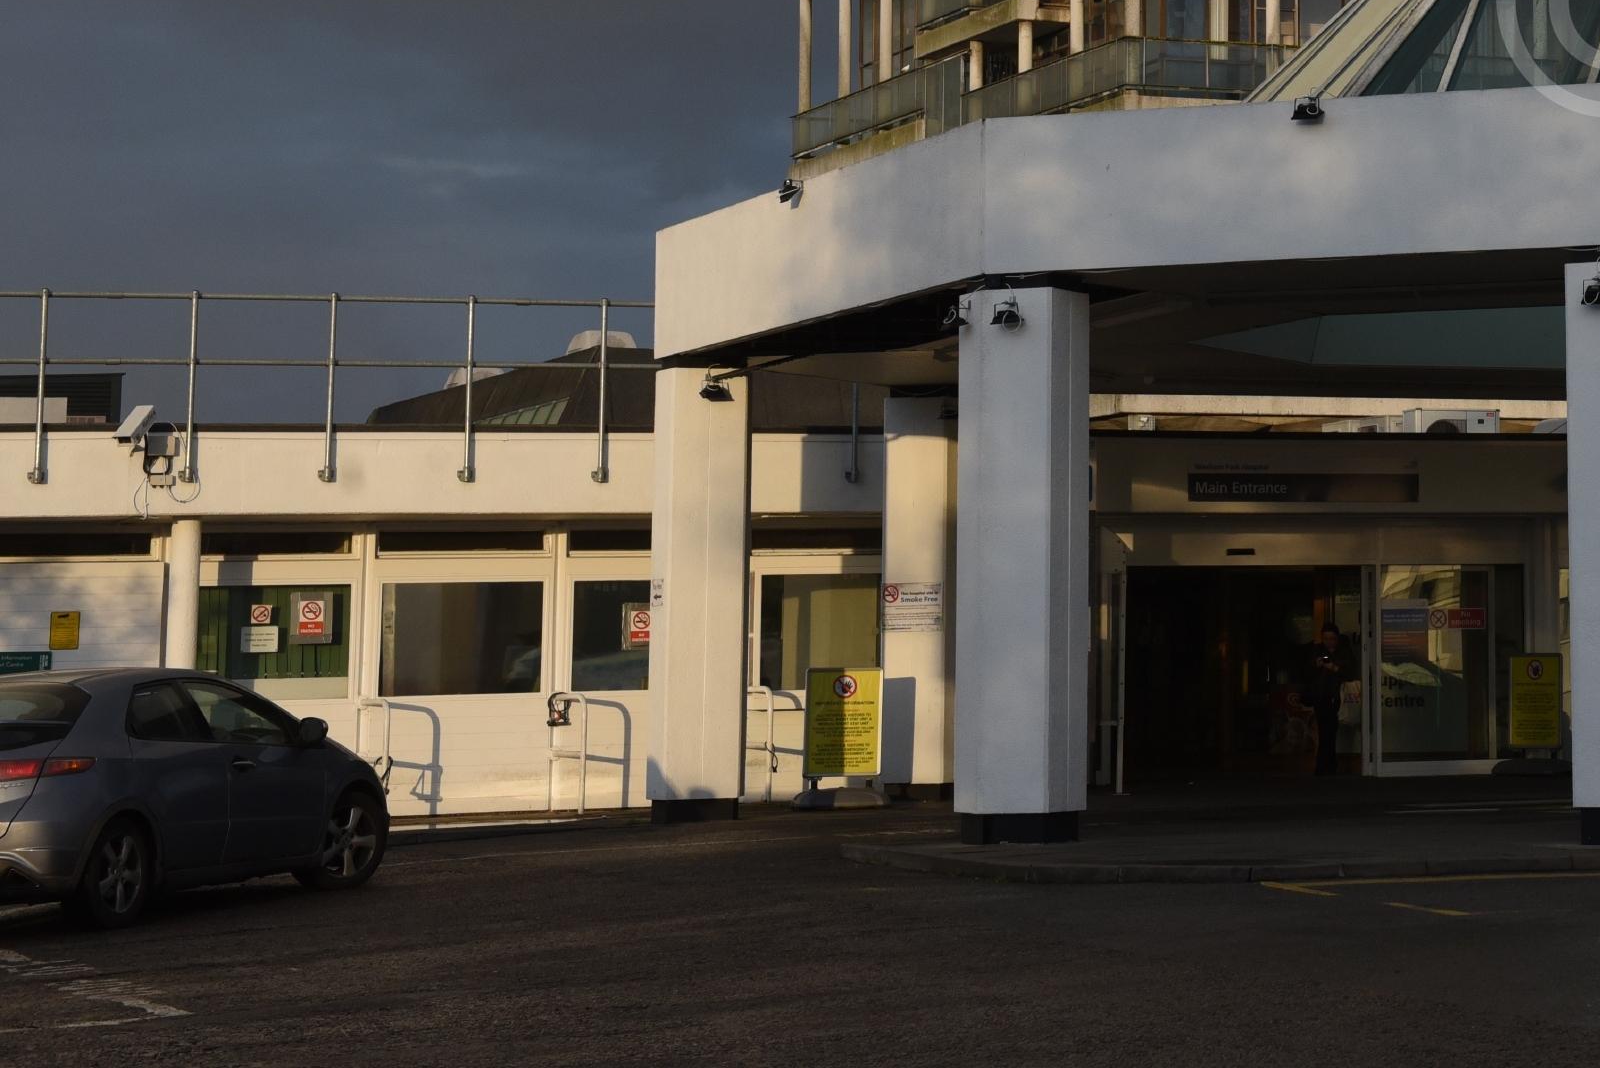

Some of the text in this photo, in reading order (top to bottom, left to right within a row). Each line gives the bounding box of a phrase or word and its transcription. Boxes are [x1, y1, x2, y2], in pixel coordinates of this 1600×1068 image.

[1195, 481, 1288, 494] Main Entrance
[1381, 693, 1426, 709] entre
